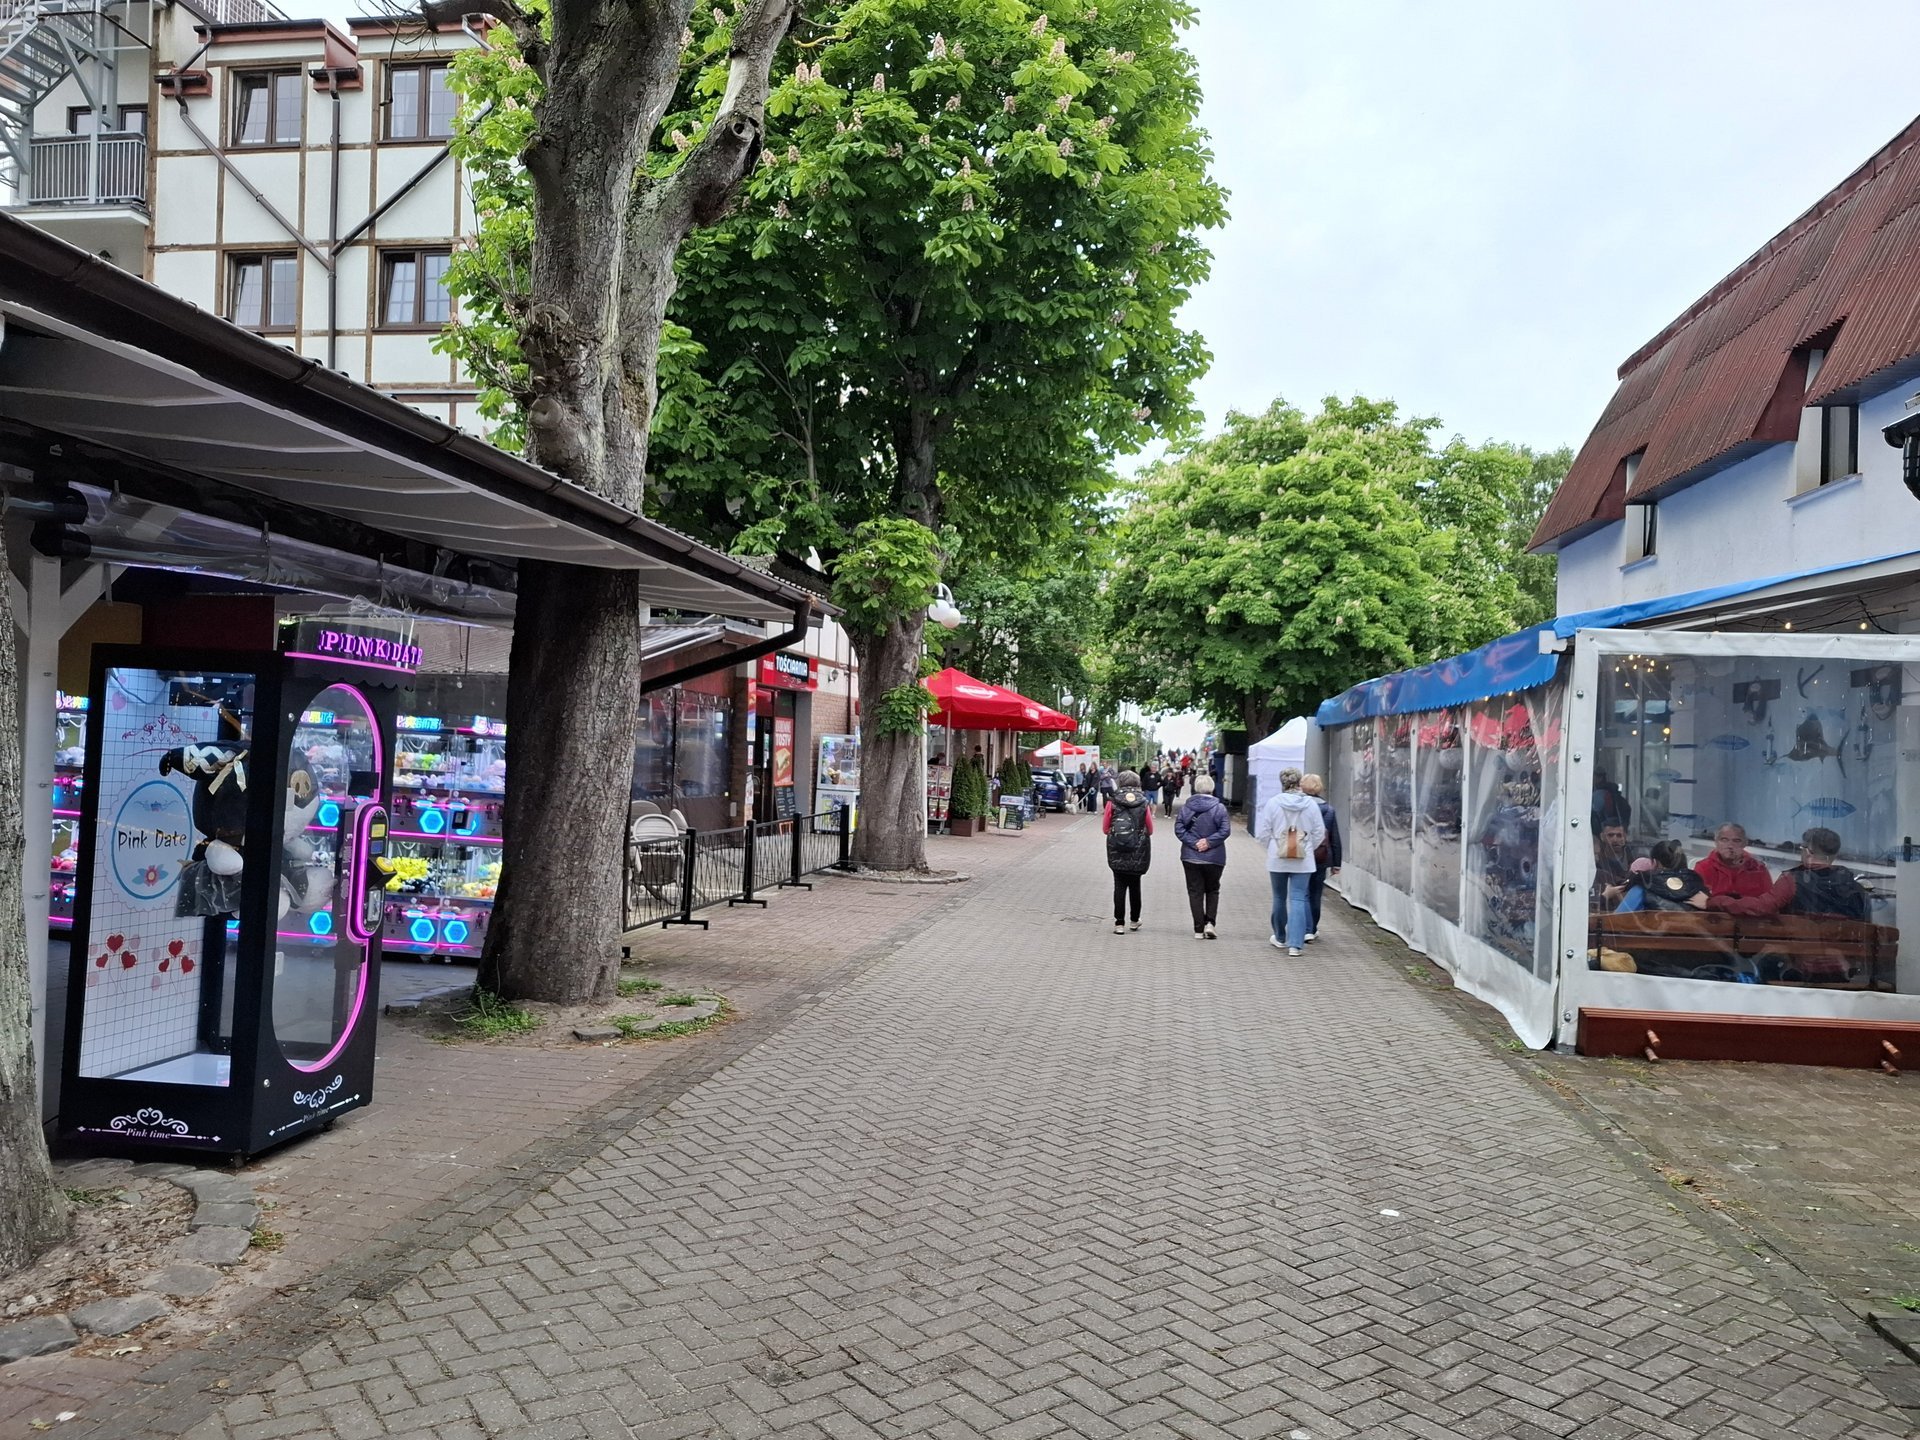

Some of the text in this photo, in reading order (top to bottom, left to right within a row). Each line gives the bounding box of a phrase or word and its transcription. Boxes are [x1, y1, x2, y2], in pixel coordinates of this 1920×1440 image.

[118, 828, 187, 852] Pink Date
[126, 1127, 171, 1139] Pink time
